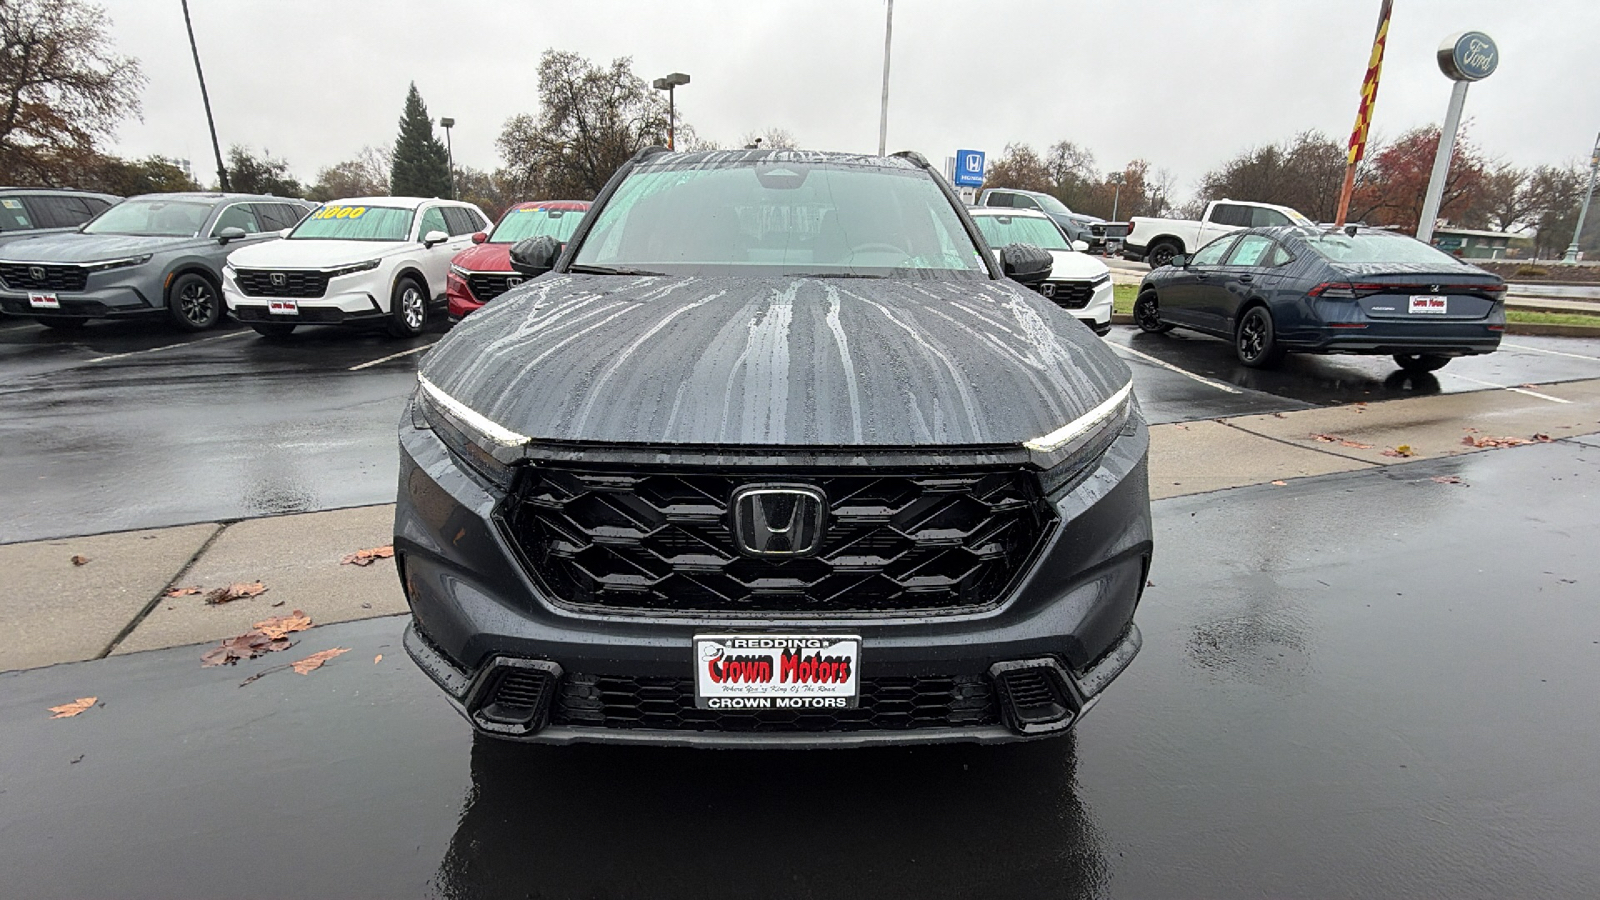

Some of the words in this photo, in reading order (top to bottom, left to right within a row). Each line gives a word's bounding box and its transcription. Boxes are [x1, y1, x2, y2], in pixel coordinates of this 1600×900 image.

[1463, 38, 1493, 70] Ford
[734, 639, 821, 648] REDDING
[708, 649, 773, 684] Crown
[780, 648, 852, 684] Motors
[770, 685, 788, 693] King
[790, 685, 800, 694] Of
[708, 697, 771, 708] CROWN
[776, 697, 847, 708] MOTORS
